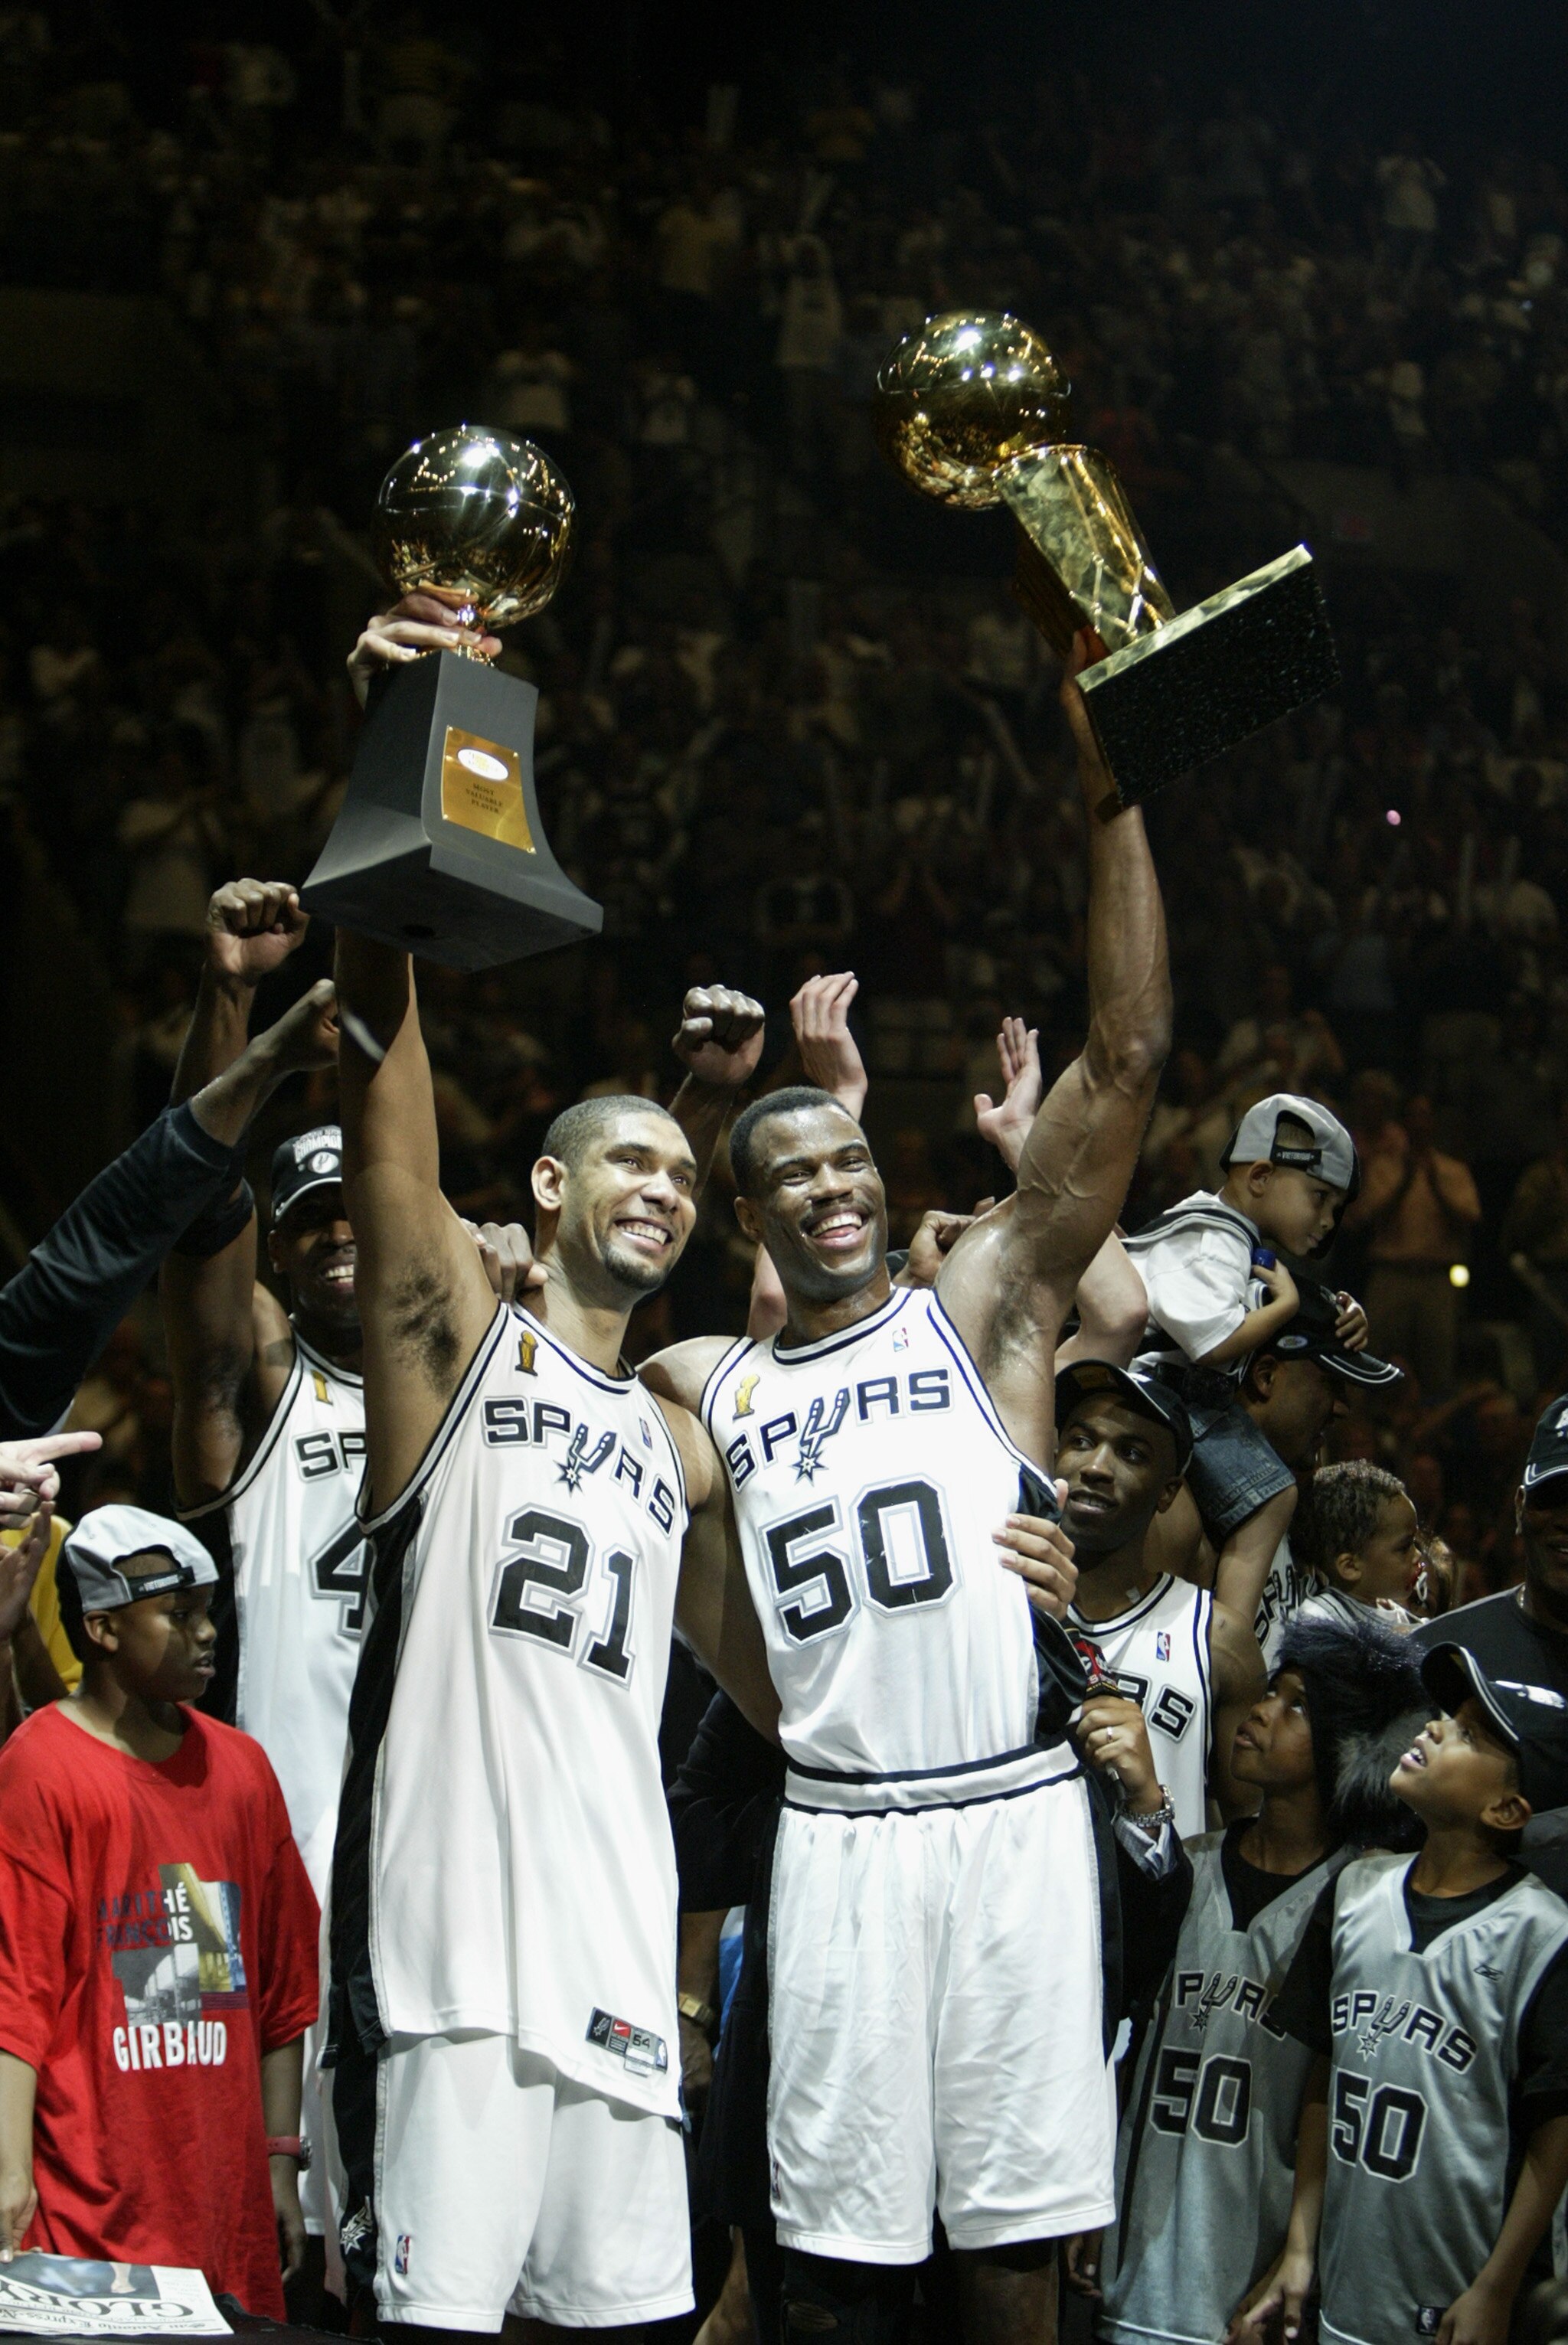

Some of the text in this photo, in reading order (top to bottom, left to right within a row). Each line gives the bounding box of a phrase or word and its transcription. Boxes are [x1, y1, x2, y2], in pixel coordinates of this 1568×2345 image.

[482, 1395, 675, 1540] SPURS
[724, 1366, 953, 1493] SPURS
[488, 1502, 640, 1690] 21
[758, 1472, 962, 1650] 50
[113, 2020, 227, 2072] GIRBAUD
[632, 2033, 651, 2049] 54
[1332, 1990, 1478, 2075] SPURS
[1149, 2046, 1253, 2148] 50
[1331, 2067, 1429, 2184] 50
